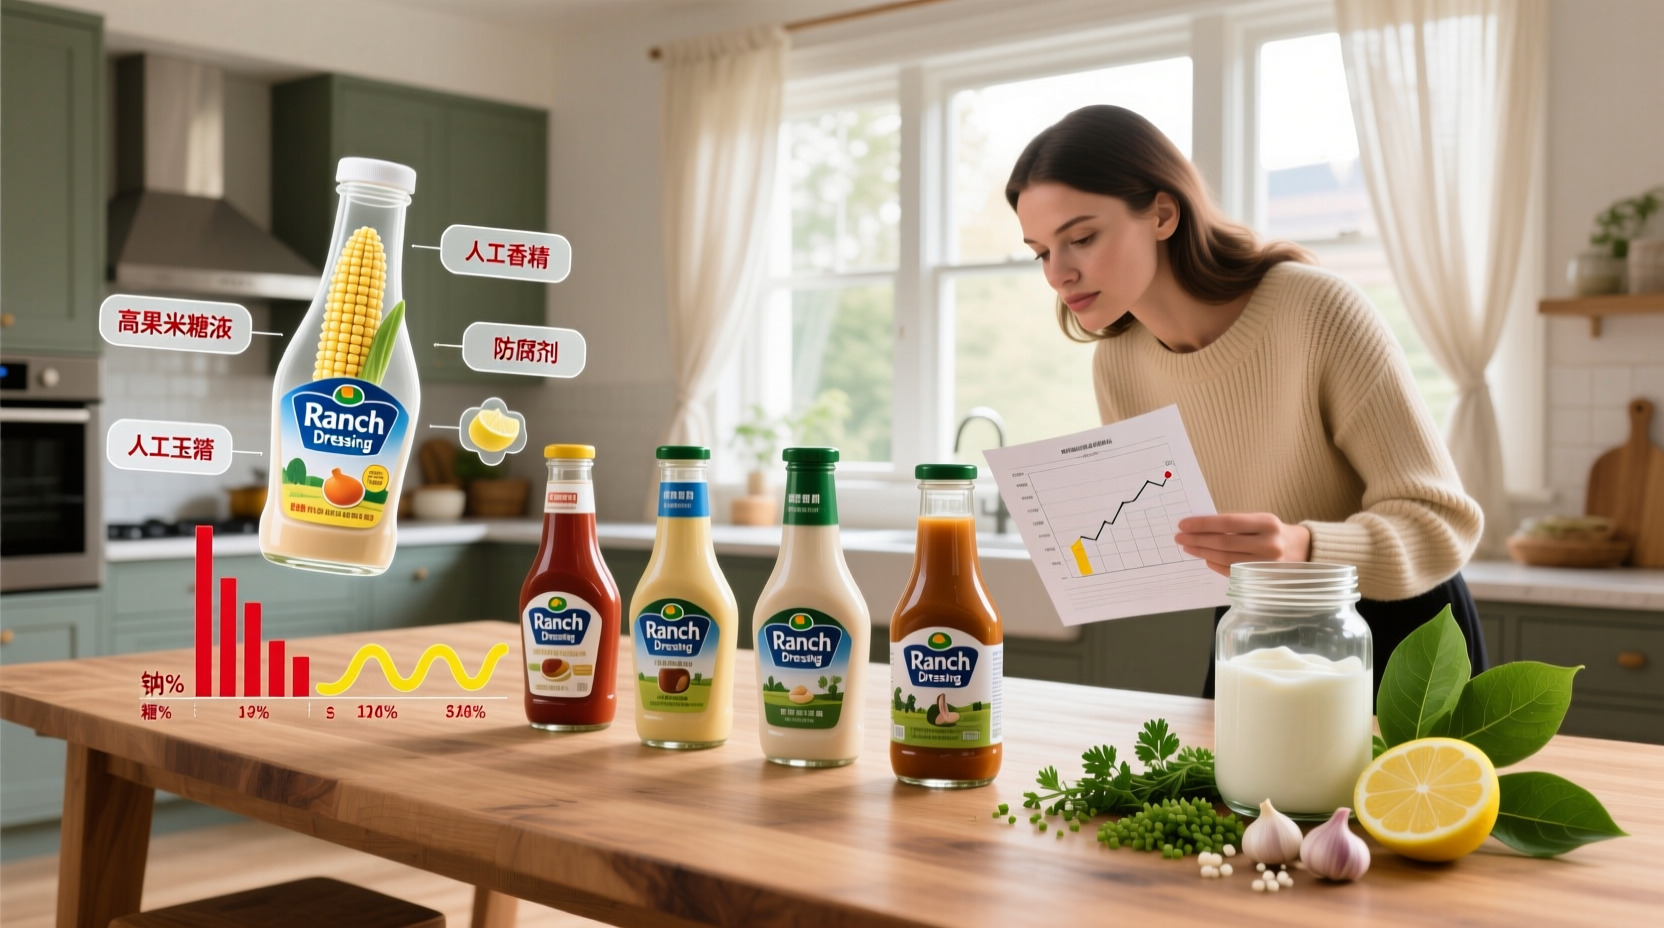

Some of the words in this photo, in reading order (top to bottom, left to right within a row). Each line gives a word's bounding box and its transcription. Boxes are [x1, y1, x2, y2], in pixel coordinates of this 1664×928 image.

[304, 402, 385, 435] Ranch
[534, 613, 583, 631] Ranch
[646, 621, 700, 640] Ranch
[773, 631, 831, 652] Ranch
[911, 650, 971, 671] Ranch
